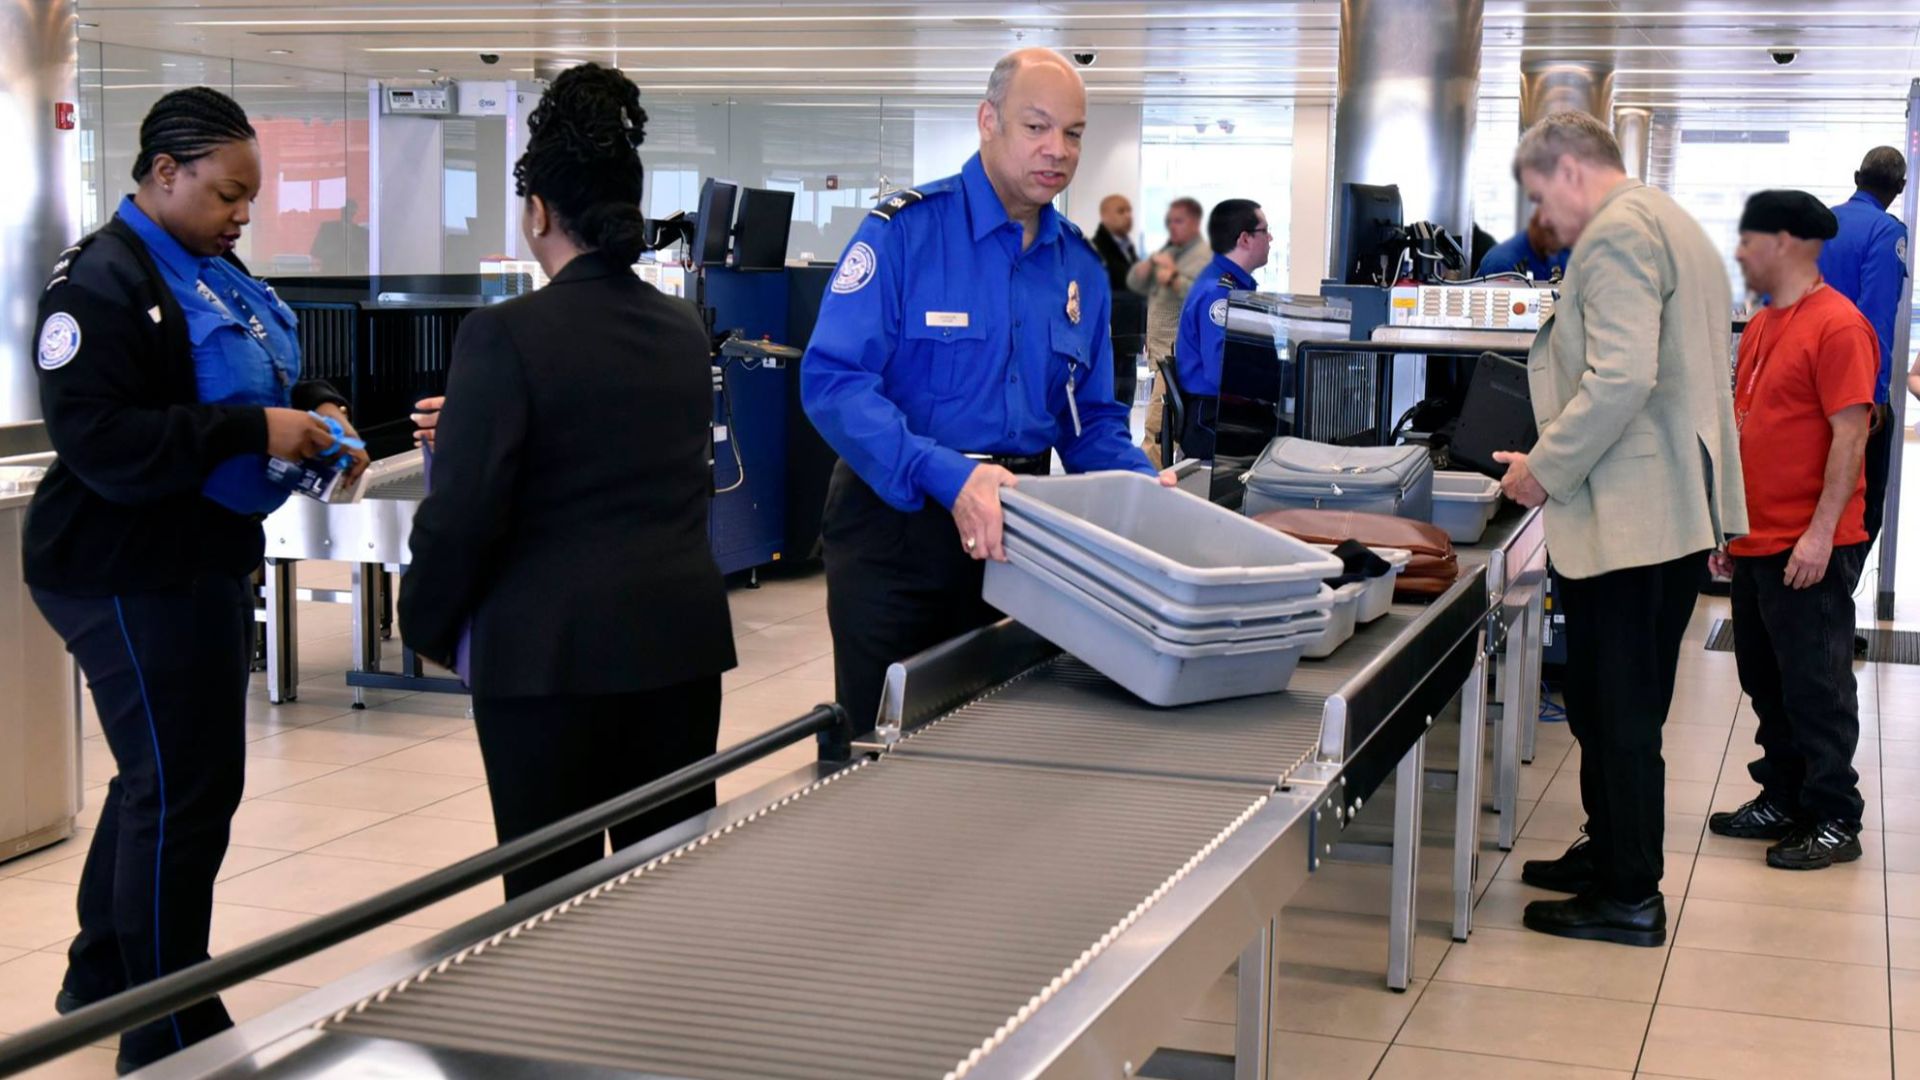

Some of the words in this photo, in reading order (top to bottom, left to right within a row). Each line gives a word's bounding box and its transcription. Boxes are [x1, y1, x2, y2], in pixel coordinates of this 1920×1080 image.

[249, 315, 268, 339] TSA
[1753, 808, 1777, 825] N
[1818, 831, 1840, 849] N
